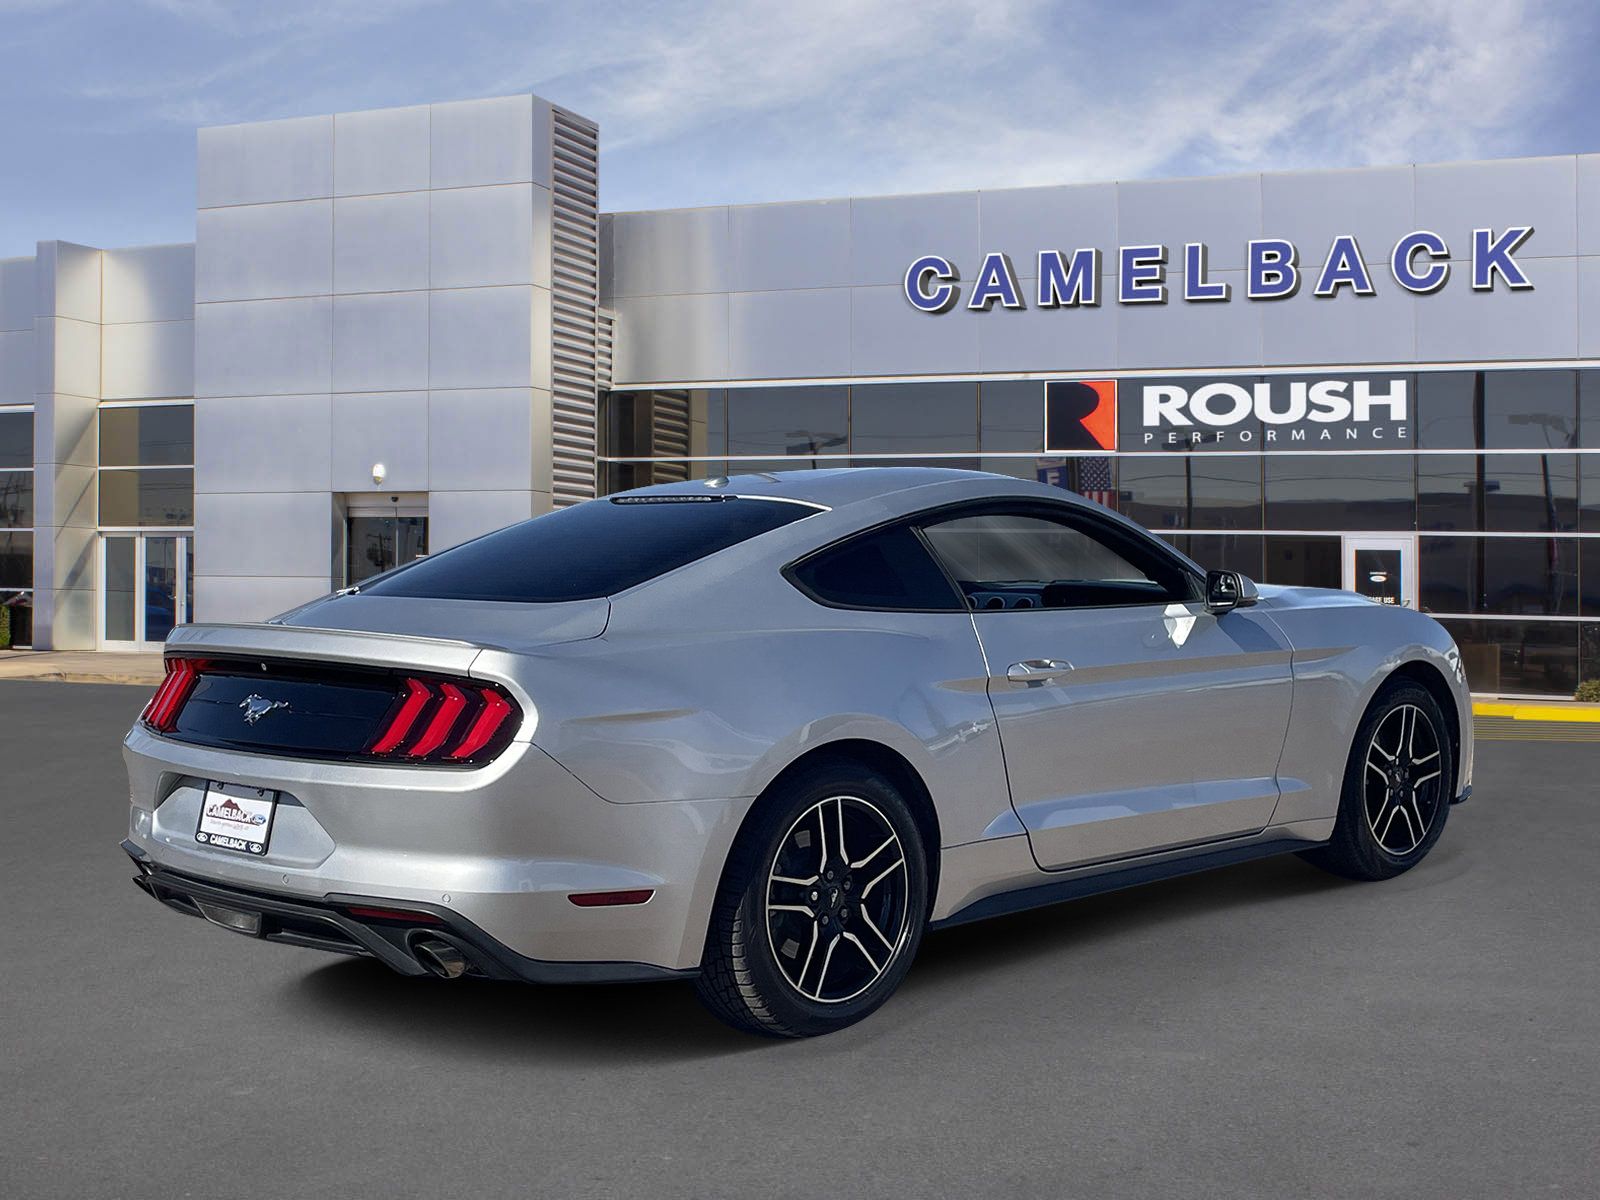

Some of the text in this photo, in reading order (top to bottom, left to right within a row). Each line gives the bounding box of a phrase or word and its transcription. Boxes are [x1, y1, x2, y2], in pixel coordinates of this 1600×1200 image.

[904, 226, 1535, 312] CAMELBACK
[1143, 380, 1407, 427] ROUSH
[1144, 427, 1407, 444] PERFORMANCE
[207, 805, 253, 824] CAMELBACK
[209, 834, 248, 851] CAMELBACK
